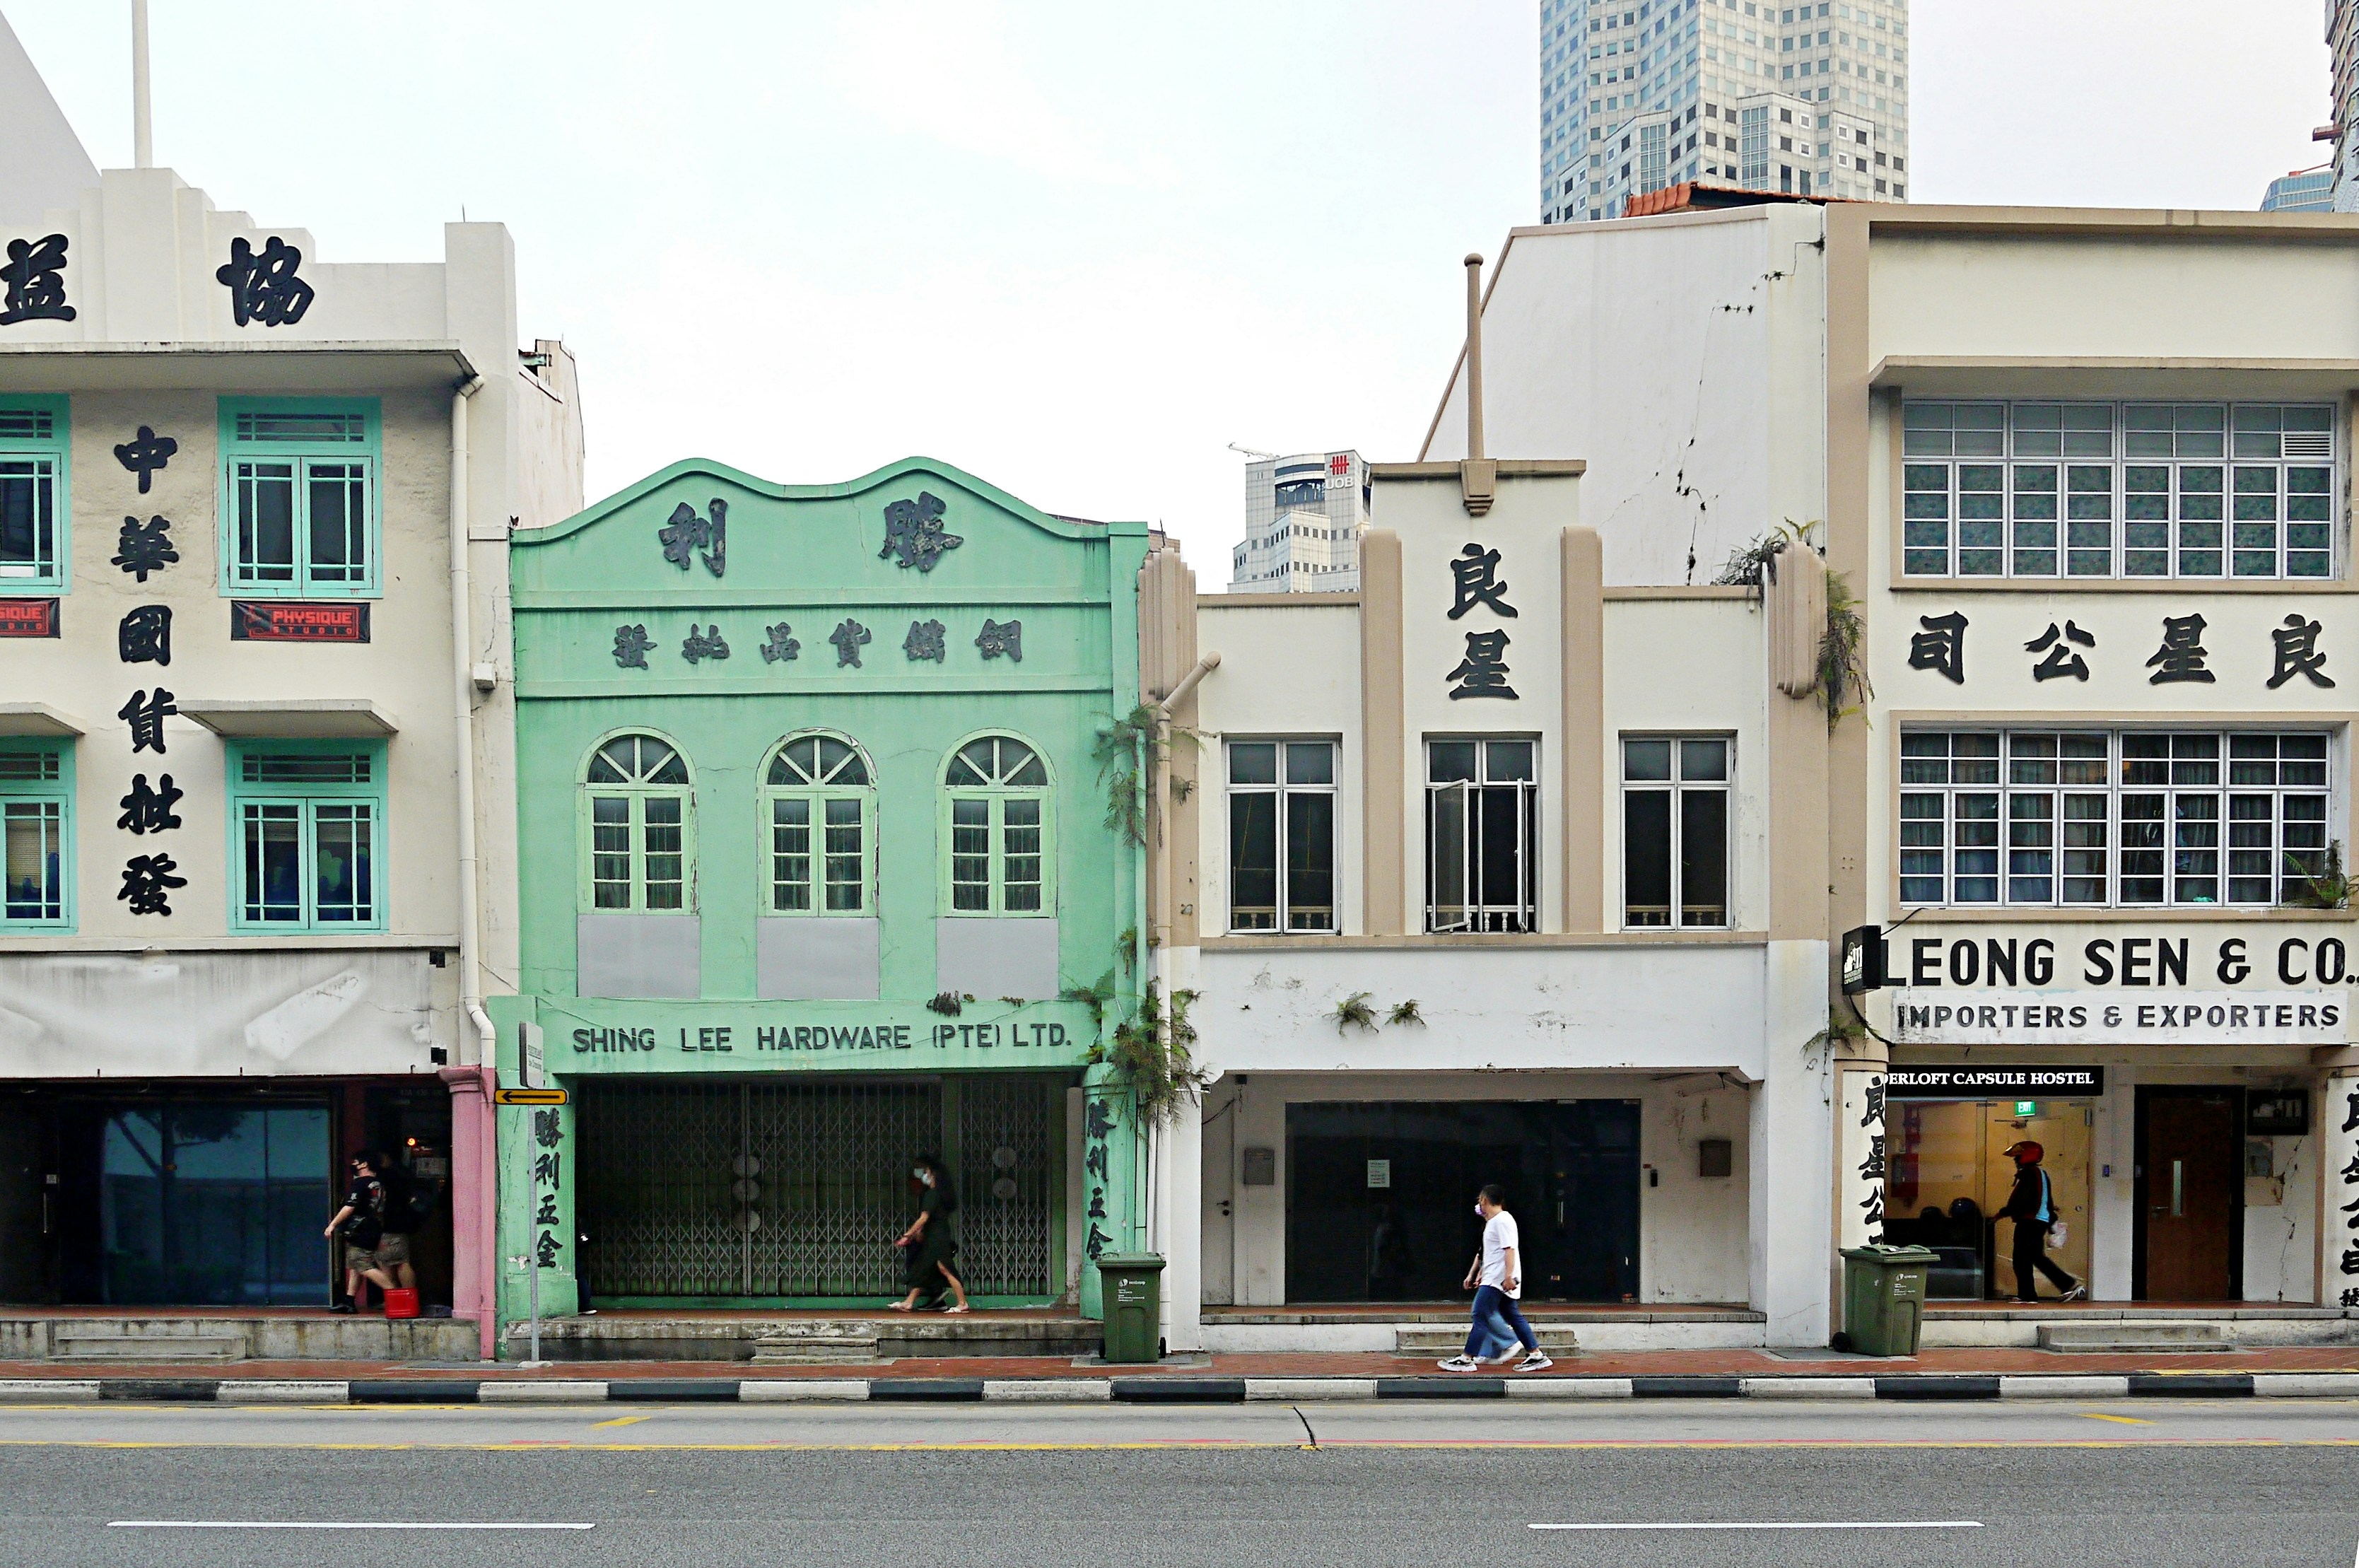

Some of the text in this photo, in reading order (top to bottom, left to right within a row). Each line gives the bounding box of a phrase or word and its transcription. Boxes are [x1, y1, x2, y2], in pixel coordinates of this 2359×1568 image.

[1325, 477, 1354, 491] UOB
[273, 609, 352, 625] PHYSIQUE
[1446, 543, 1521, 701] 良星
[273, 626, 352, 634] STUDIO
[1880, 938, 2054, 987] LEONG
[2084, 938, 2189, 986] SEN
[2217, 937, 2251, 985] &
[1898, 1005, 2339, 1028] IMPORTERS & EXPORTERS
[573, 1027, 655, 1053] SHING
[680, 1026, 733, 1052] LEE
[757, 1024, 911, 1051] HARDWARE
[932, 1024, 1000, 1048] (PTE)
[1012, 1023, 1072, 1047] LTD.
[1953, 1072, 2026, 1086] CAPSULE
[2030, 1072, 2094, 1085] HOSTEL
[2018, 1101, 2032, 1113] EXIT
